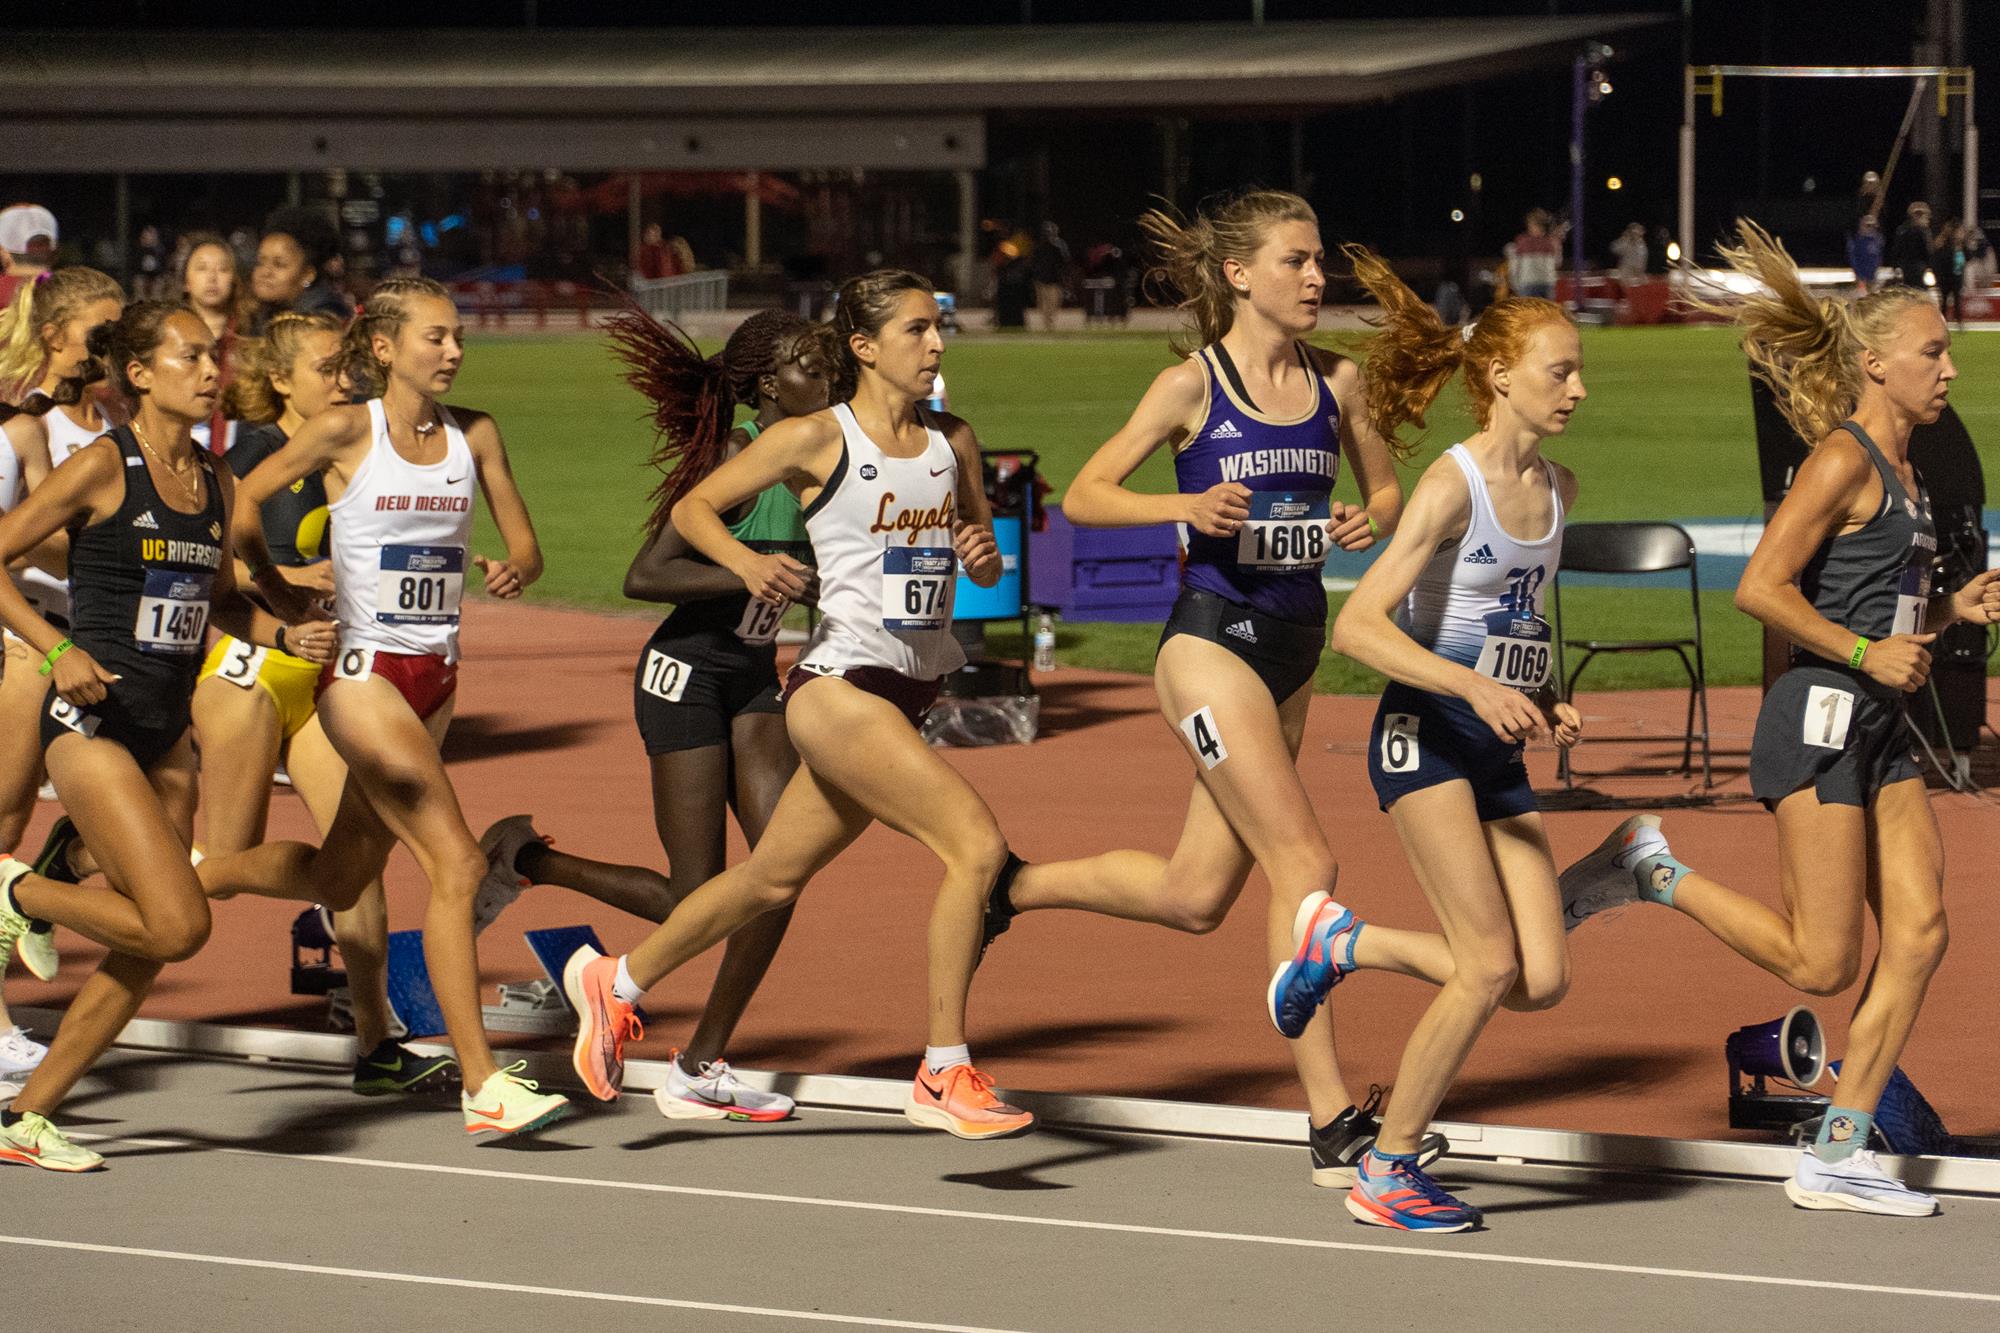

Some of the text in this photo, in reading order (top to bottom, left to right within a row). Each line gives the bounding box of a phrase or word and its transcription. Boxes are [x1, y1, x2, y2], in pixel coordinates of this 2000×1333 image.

[1210, 430, 1243, 439] adidas
[375, 496, 469, 512] NEW MEXICO
[142, 538, 165, 560] UC
[1253, 524, 1324, 560] 1608
[1464, 556, 1498, 564] adidas
[398, 577, 446, 610] 801
[151, 603, 204, 640] 1450
[1225, 626, 1258, 644] adidas
[650, 656, 680, 695] 10
[1492, 642, 1548, 683] 1069
[1193, 712, 1220, 760] 4
[1819, 692, 1841, 744] 1
[1387, 716, 1409, 769] 6
